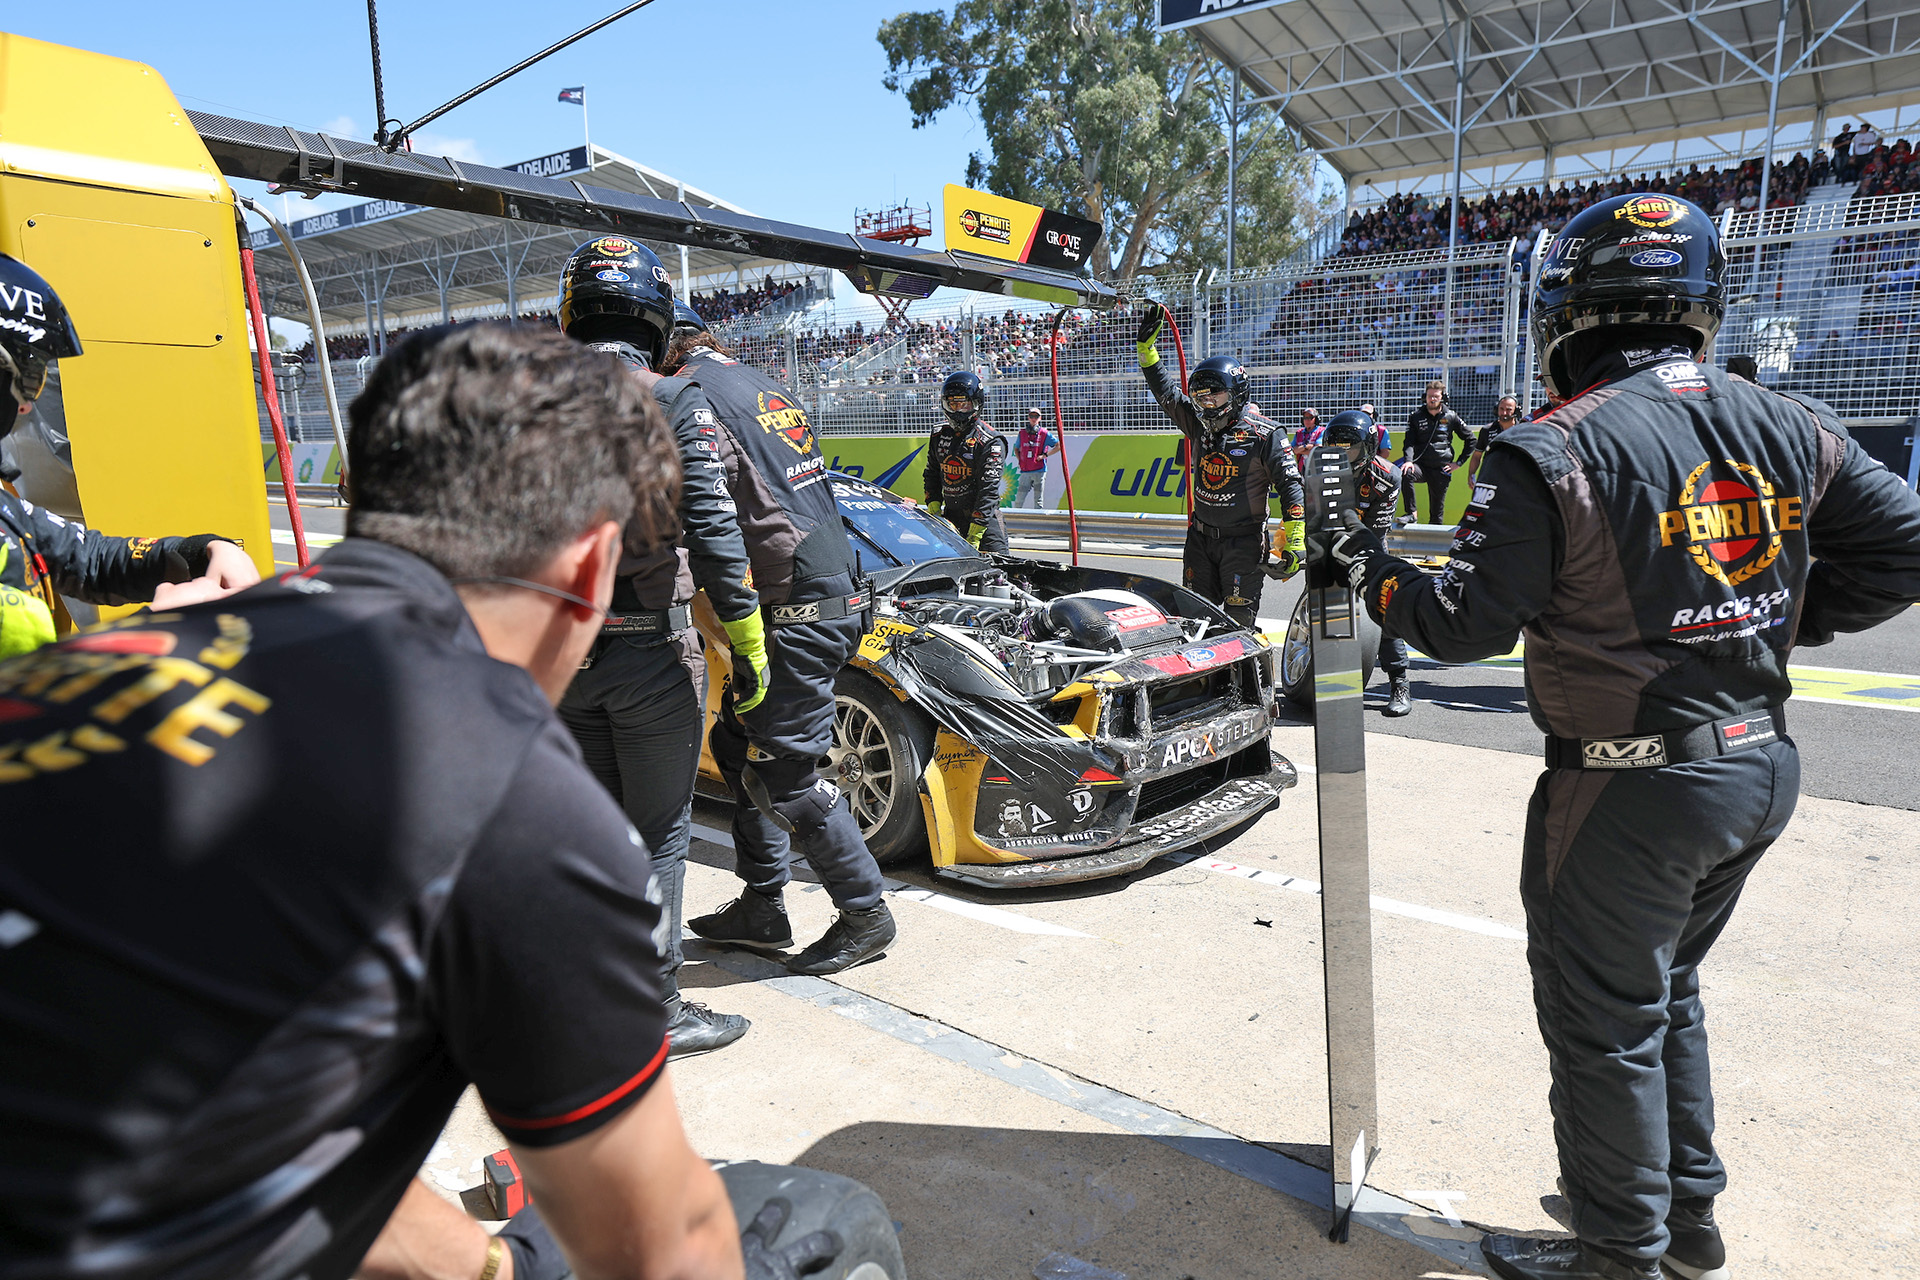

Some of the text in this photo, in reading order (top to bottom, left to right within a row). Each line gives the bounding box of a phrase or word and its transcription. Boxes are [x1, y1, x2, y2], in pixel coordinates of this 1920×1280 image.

[517, 152, 571, 177] ADELAIDE
[364, 200, 407, 220] ADELAIDE
[1614, 201, 1690, 220] PENRITE
[302, 212, 340, 235] ADELAIDE
[980, 213, 1010, 231] PENRITE
[250, 230, 269, 247] LAIDE
[590, 239, 639, 253] PENRITE
[1046, 230, 1081, 250] GROVE
[1619, 232, 1671, 246] RACING
[1544, 237, 1585, 261] OVE
[0, 281, 46, 321] VE
[1655, 364, 1699, 380] OMP
[1199, 457, 1239, 477] PENRITE
[1473, 487, 1495, 504] MP
[839, 499, 887, 512] Payne
[1658, 495, 1802, 547] PENRITE
[1456, 528, 1487, 547] OVE
[1120, 614, 1161, 628] PROTECTED
[1217, 721, 1256, 747] STEEL
[1585, 753, 1664, 767] MECHANIX WEAR
[1005, 832, 1095, 848] AUSTRALIAN WHISKY
